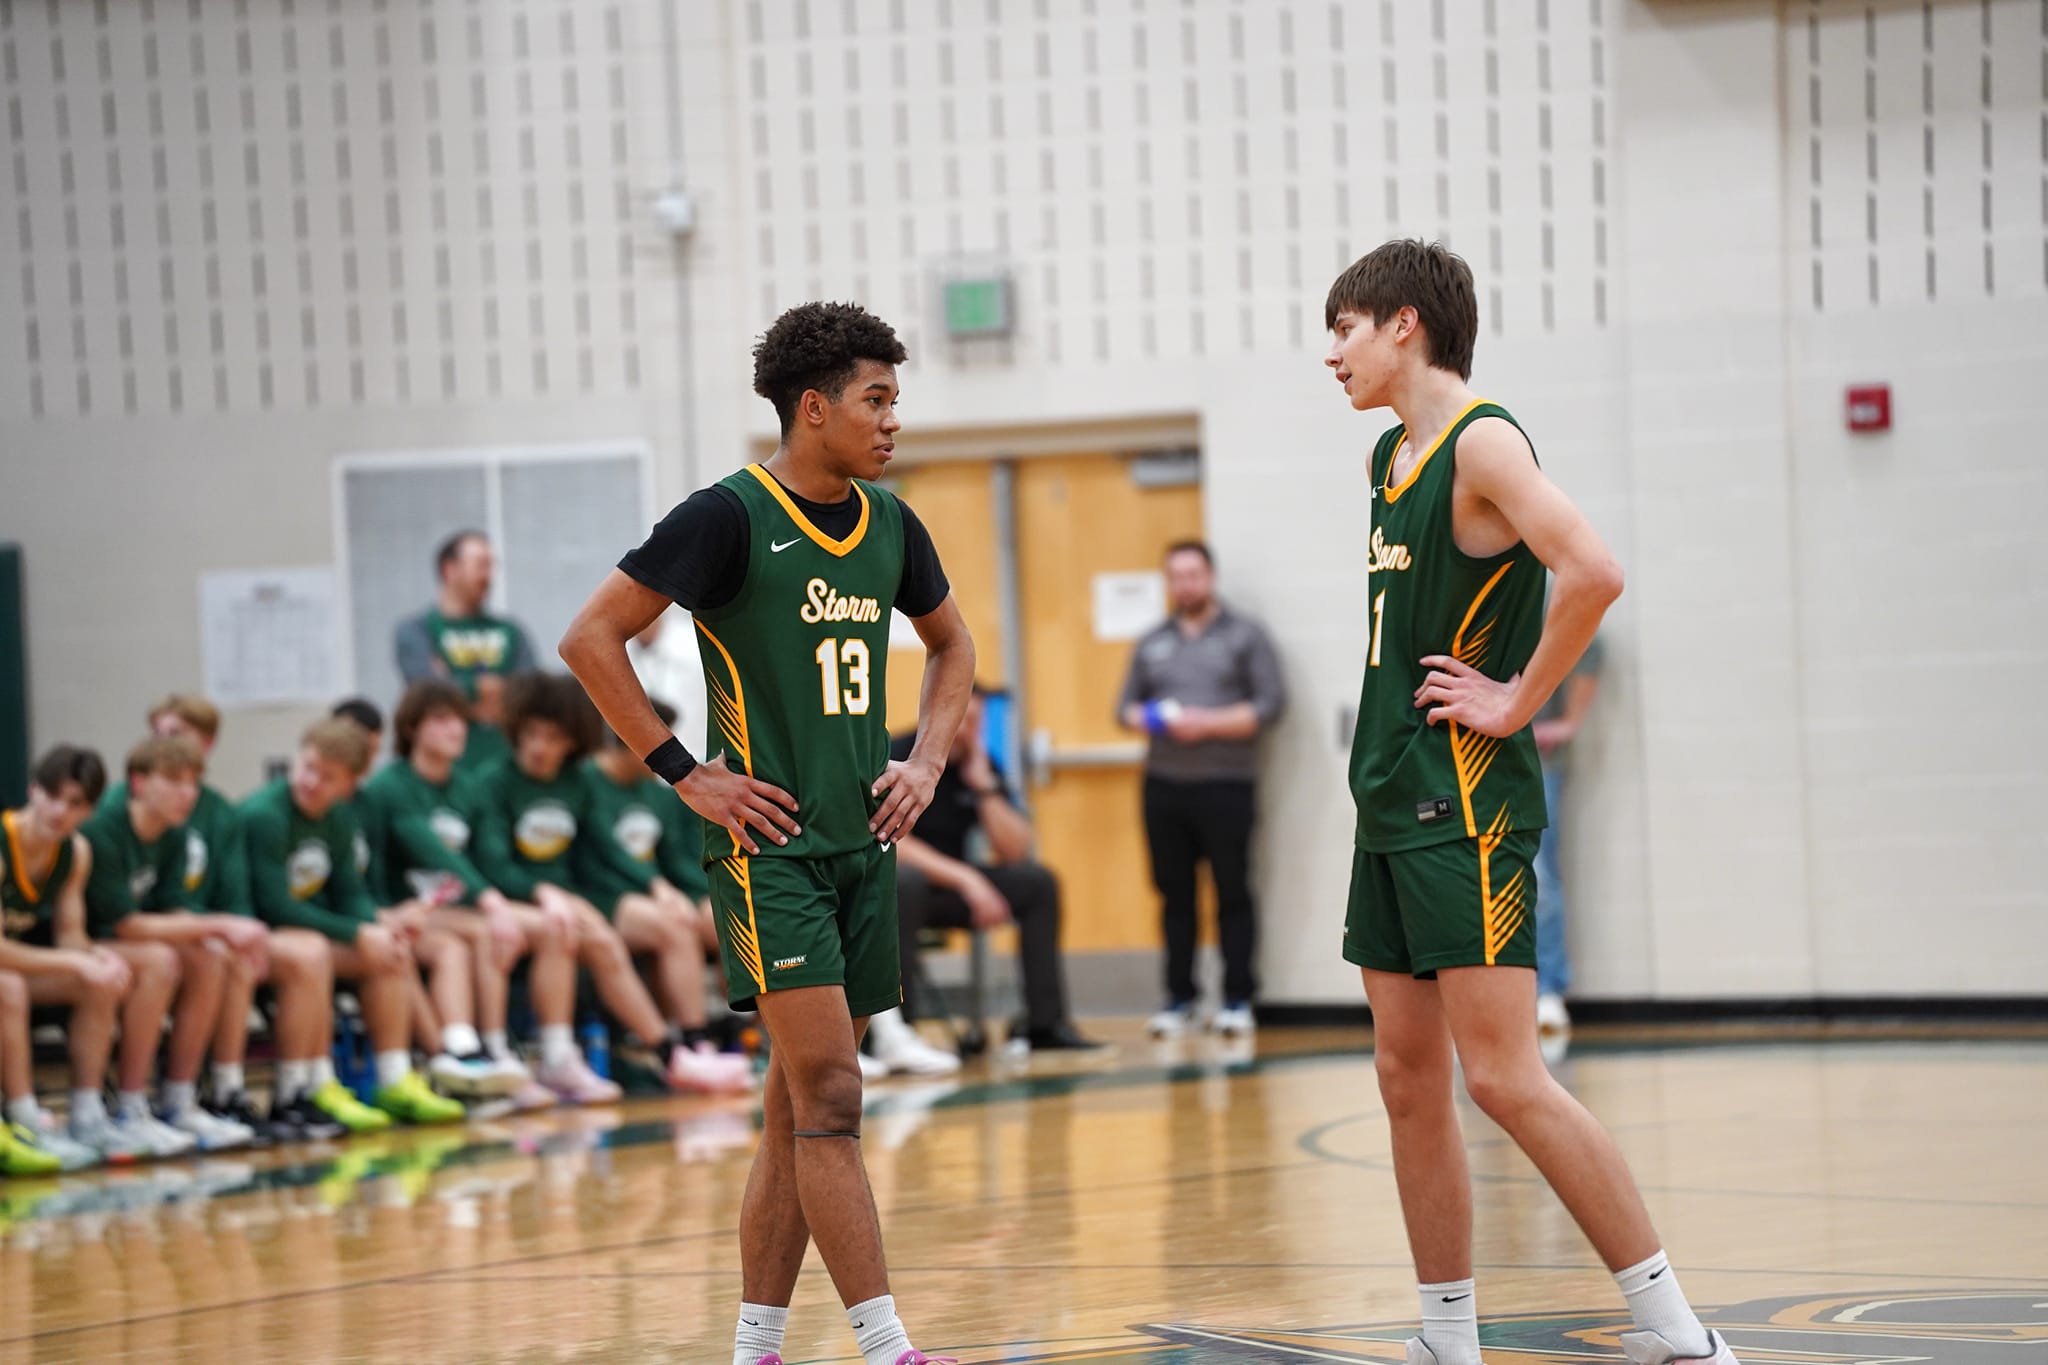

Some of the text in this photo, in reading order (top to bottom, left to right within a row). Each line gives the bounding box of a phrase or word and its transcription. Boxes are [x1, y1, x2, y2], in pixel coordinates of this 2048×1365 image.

[800, 577, 881, 624] Storm
[815, 637, 870, 716] 13
[773, 955, 806, 968] STORM
